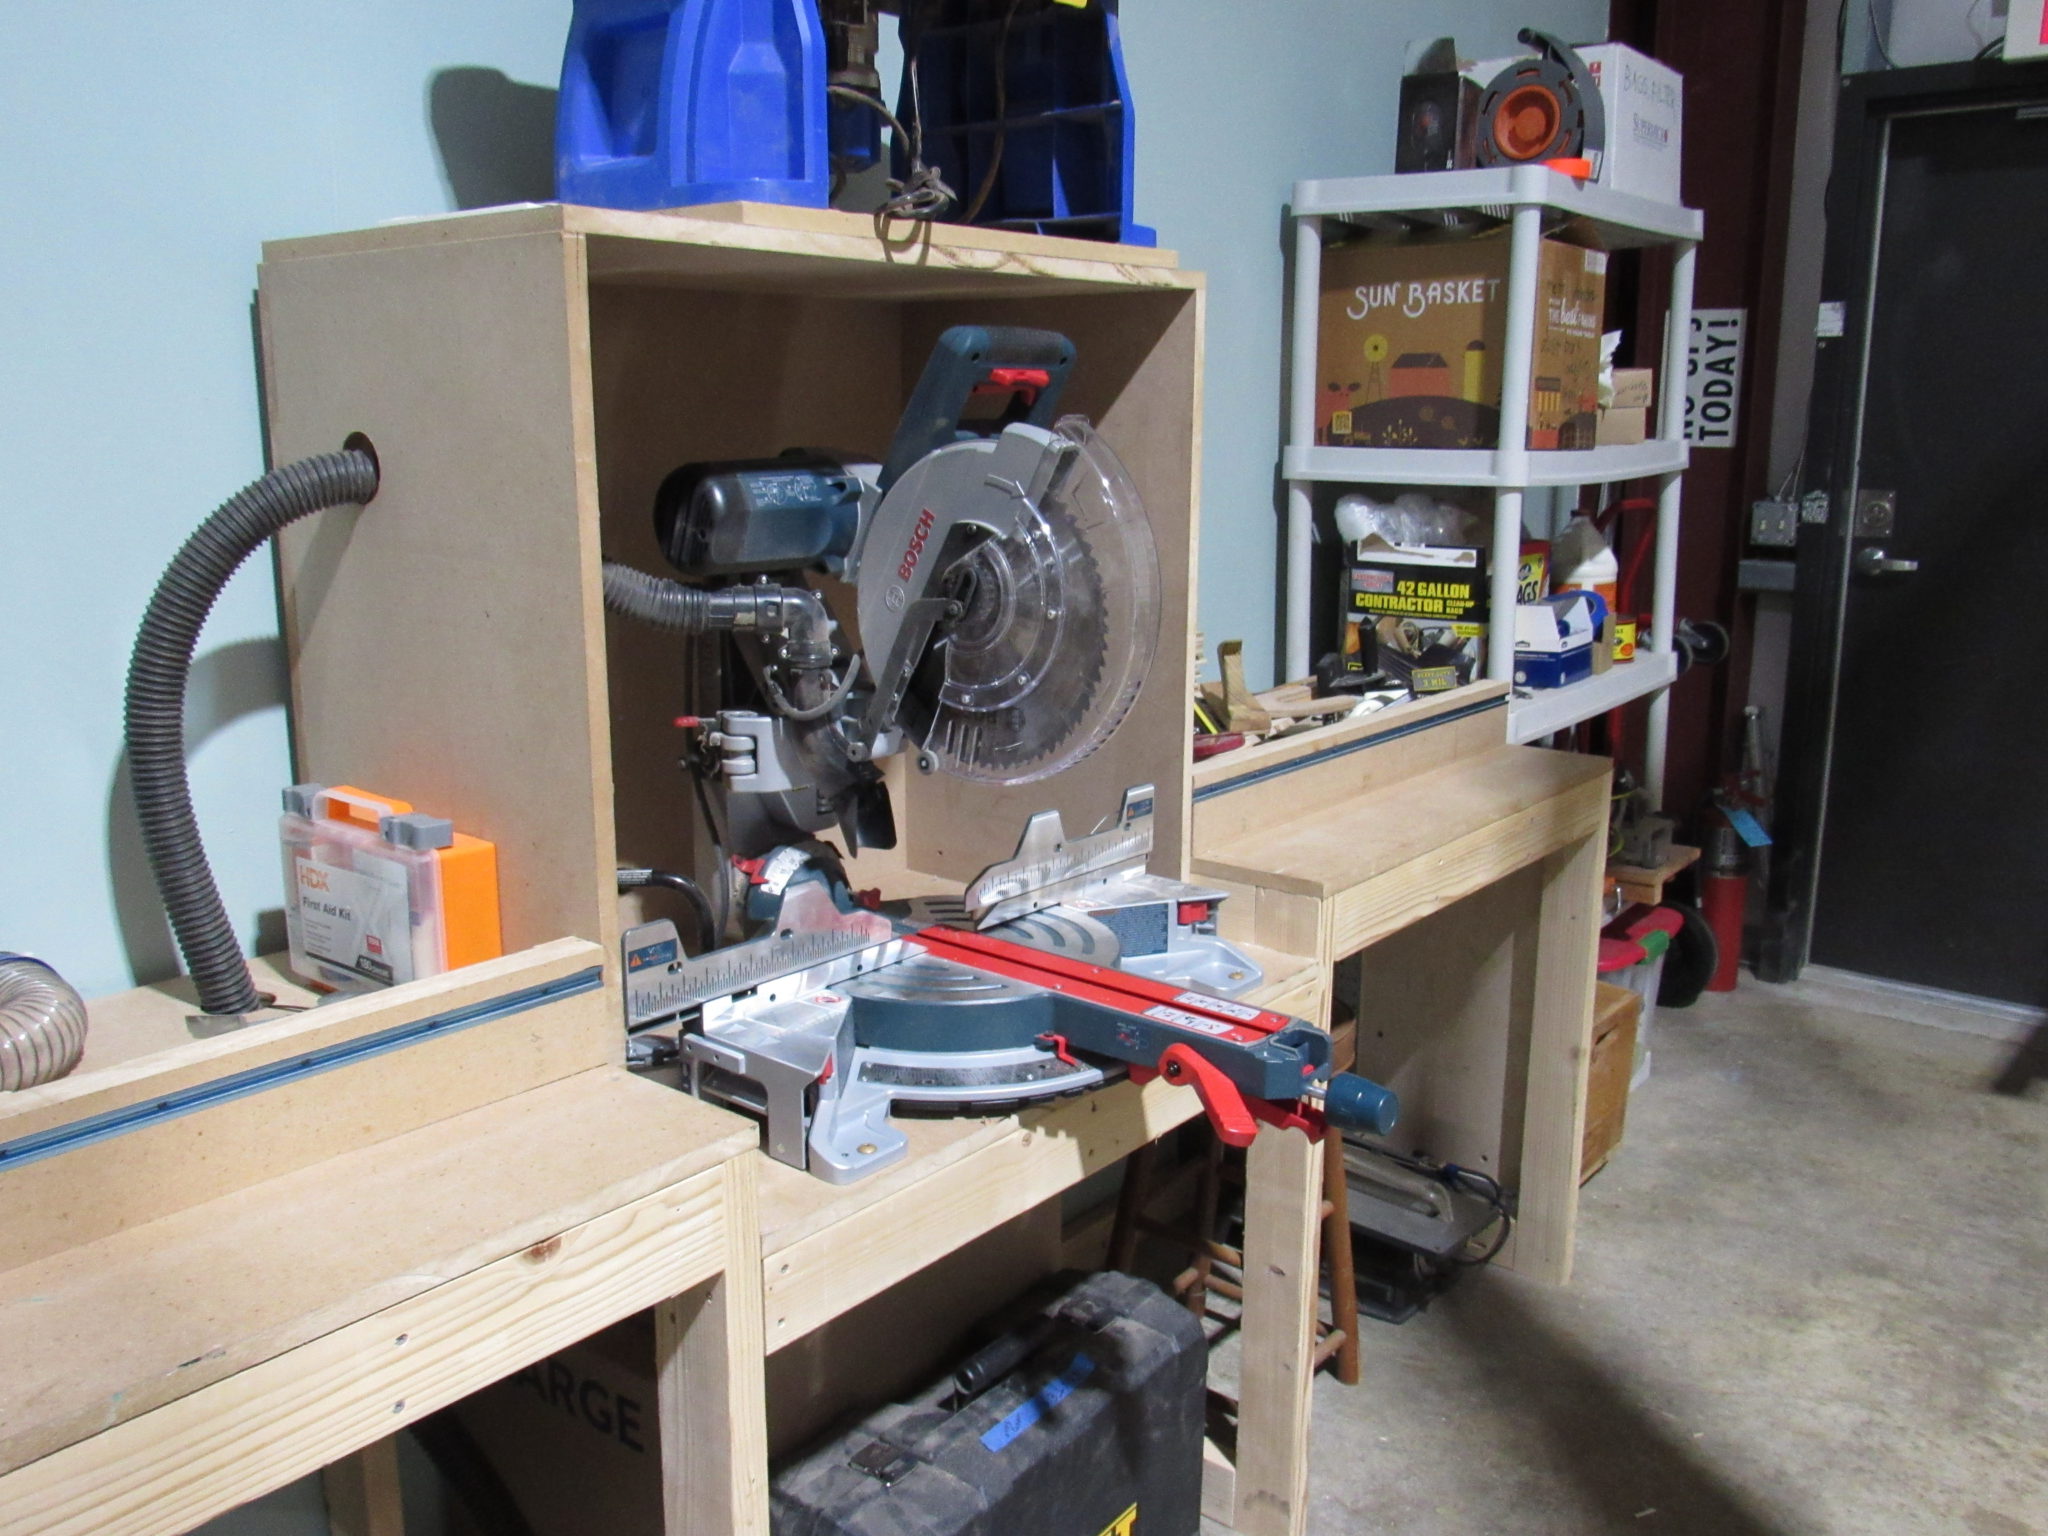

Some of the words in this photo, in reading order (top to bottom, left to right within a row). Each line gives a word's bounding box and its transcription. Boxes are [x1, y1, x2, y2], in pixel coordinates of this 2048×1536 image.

[1347, 282, 1401, 320] SUN
[1403, 279, 1500, 318] BASKET
[1699, 318, 1738, 441] TODAY!
[898, 507, 936, 583] BOSCH
[1355, 592, 1443, 613] CONTRACTOR
[1397, 580, 1415, 596] 42
[1417, 582, 1470, 599] GALLON
[1516, 580, 1538, 605] AGS
[301, 865, 330, 892] HDX
[303, 896, 320, 910] First
[323, 903, 337, 917] Aid
[339, 908, 351, 921] Kit
